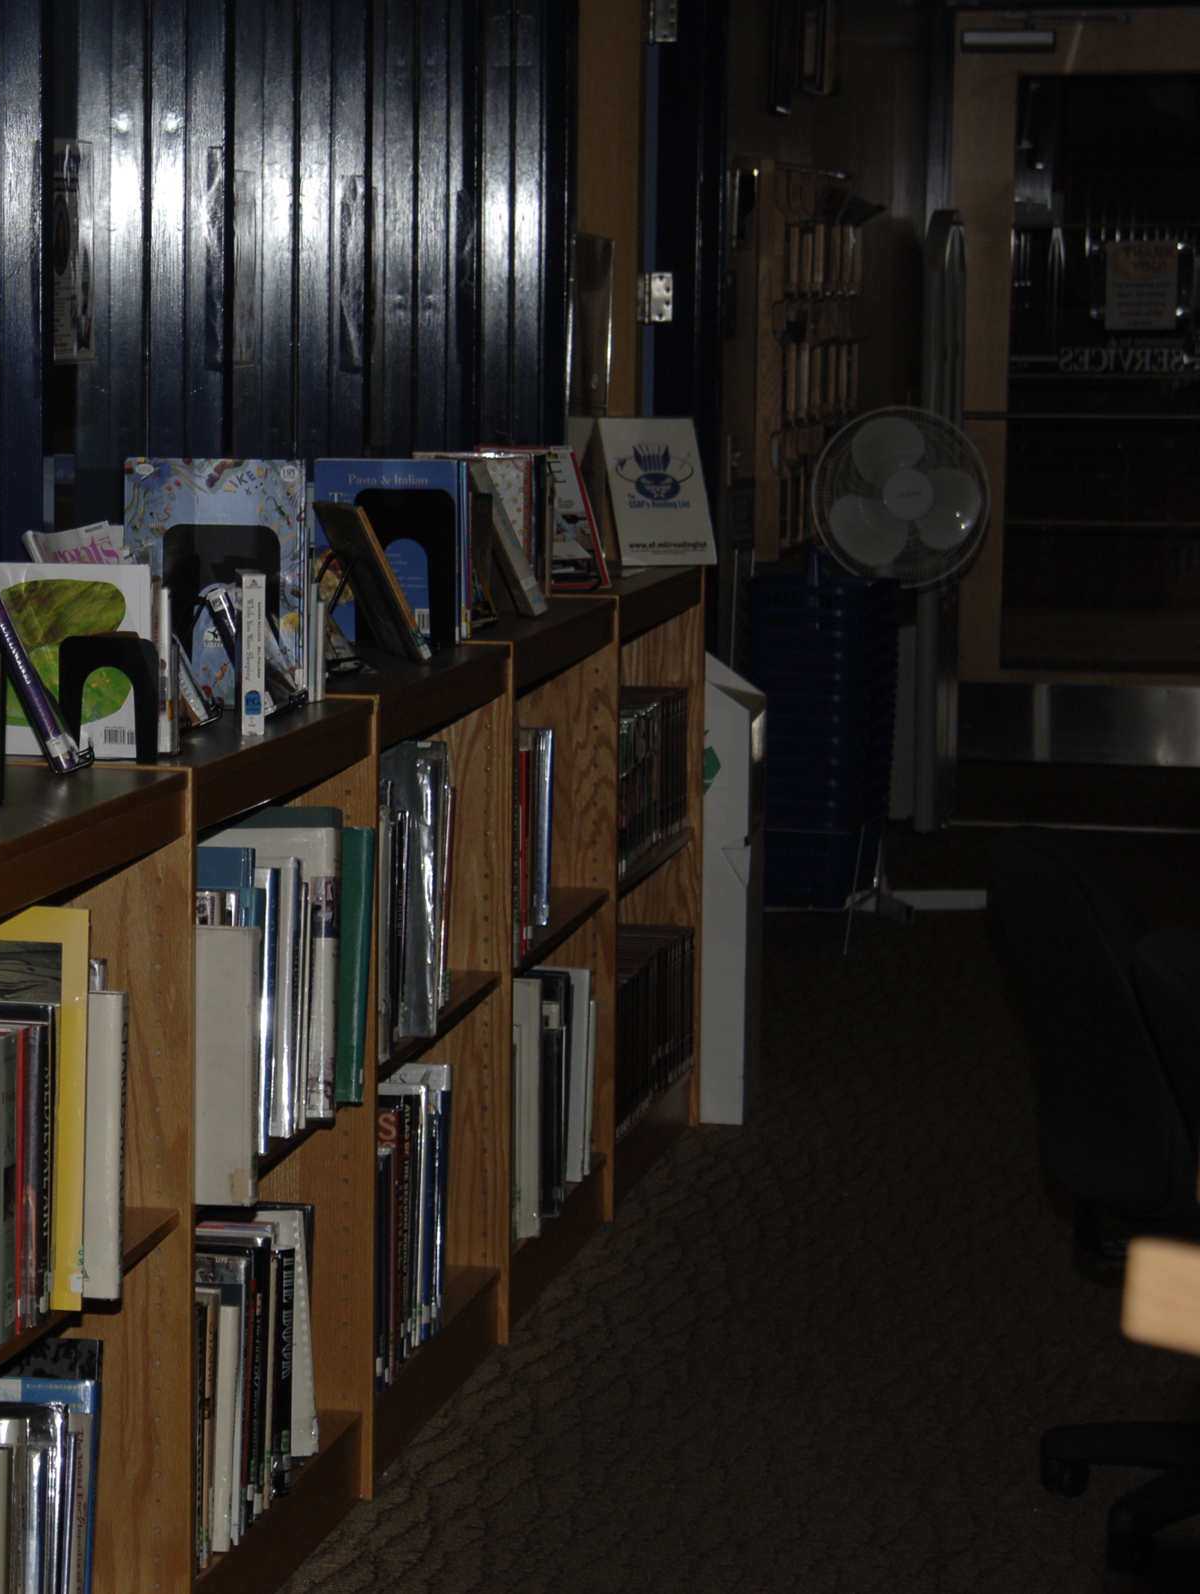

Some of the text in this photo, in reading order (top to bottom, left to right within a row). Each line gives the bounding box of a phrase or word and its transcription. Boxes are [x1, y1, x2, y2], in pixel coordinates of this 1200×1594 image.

[348, 474, 429, 485] Pasta & Italian
[245, 599, 254, 619] While
[245, 619, 254, 632] You
[244, 652, 253, 681] Sleeping
[246, 697, 260, 706] PG
[76, 1493, 85, 1569] Encyclopedia
